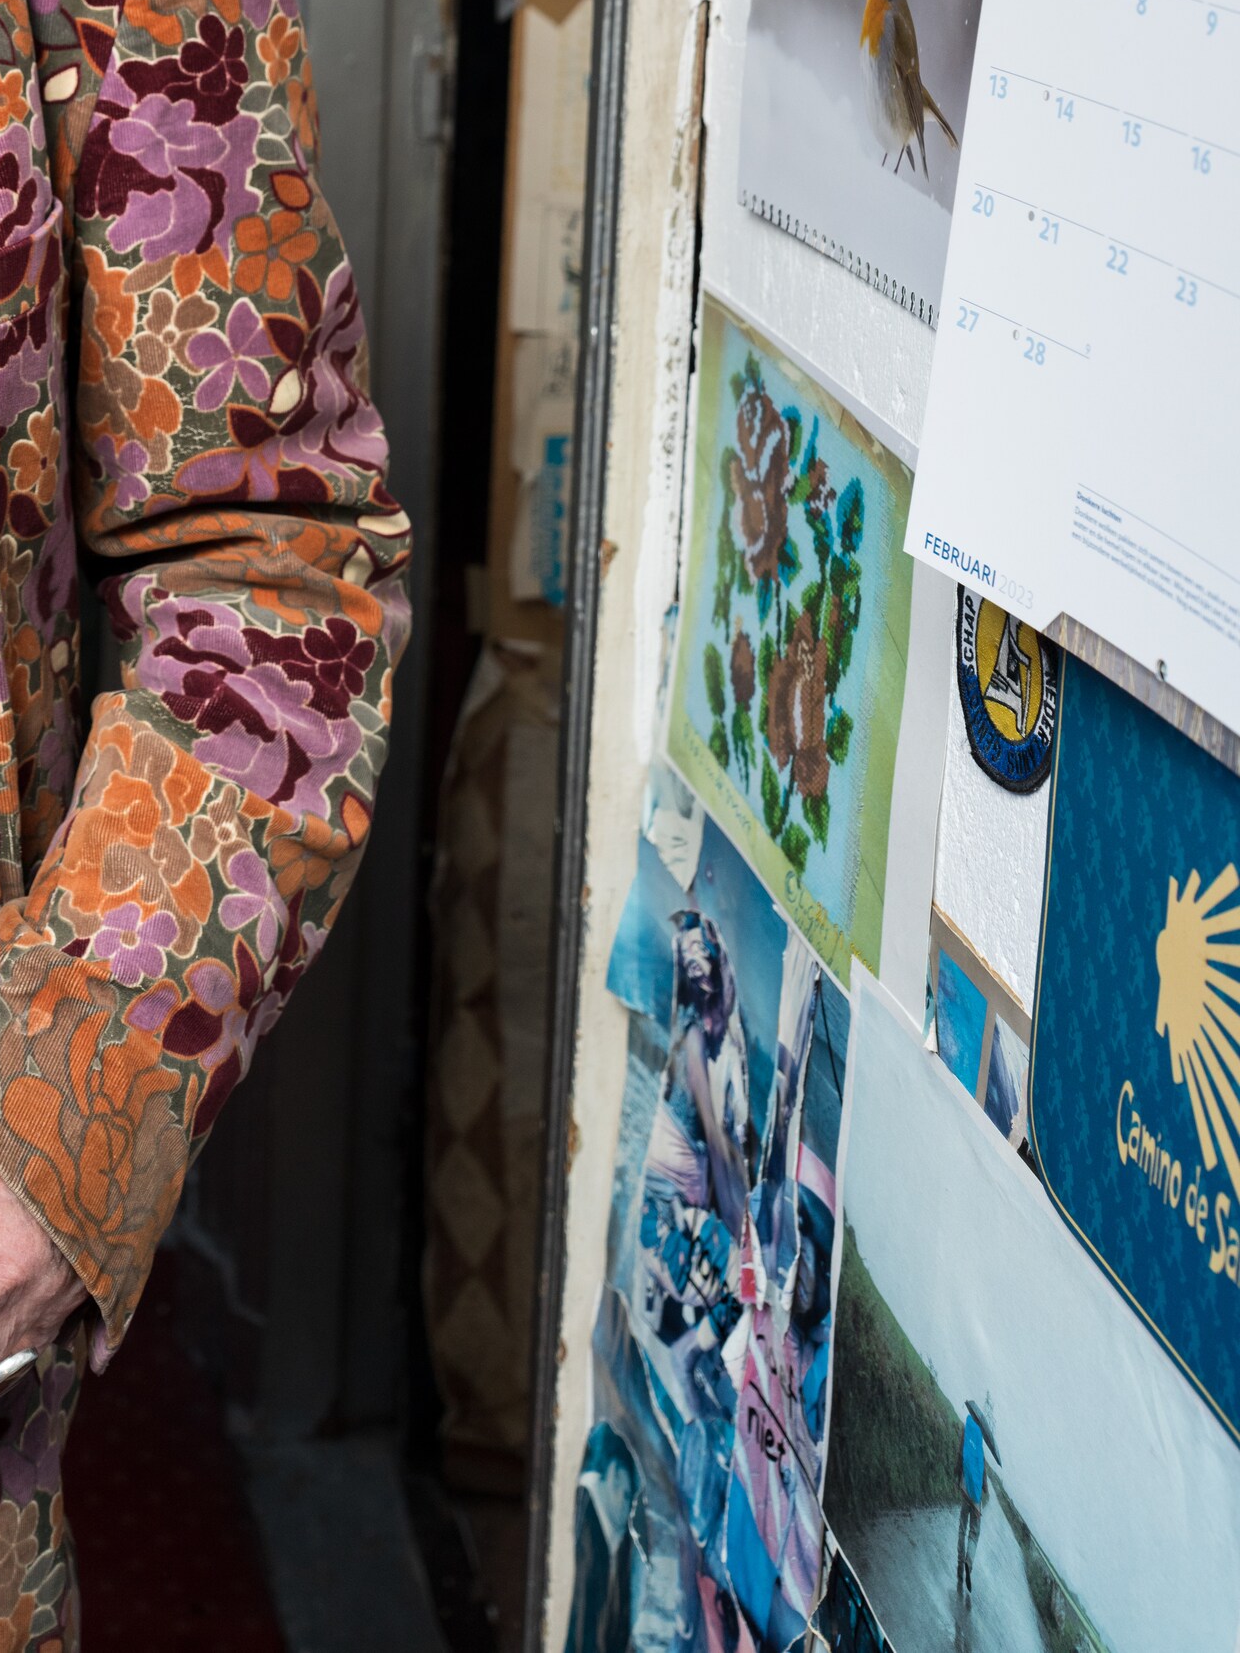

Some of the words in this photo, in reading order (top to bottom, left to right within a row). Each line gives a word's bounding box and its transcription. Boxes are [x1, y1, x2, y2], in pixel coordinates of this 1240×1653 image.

[1206, 10, 1219, 36] 9
[989, 74, 1009, 100] 13
[1055, 96, 1075, 123] 14
[1122, 120, 1143, 148] 15
[1191, 146, 1212, 176] 16
[972, 189, 995, 218] 20
[1038, 216, 1060, 245] 21
[1106, 244, 1130, 276] 22
[1174, 274, 1198, 307] 23
[956, 305, 980, 333] 27
[1023, 336, 1047, 367] 28
[924, 532, 997, 588] FEBRUARI
[998, 574, 1035, 610] 2023
[1116, 1079, 1183, 1209] Camino
[1184, 1164, 1209, 1244] de
